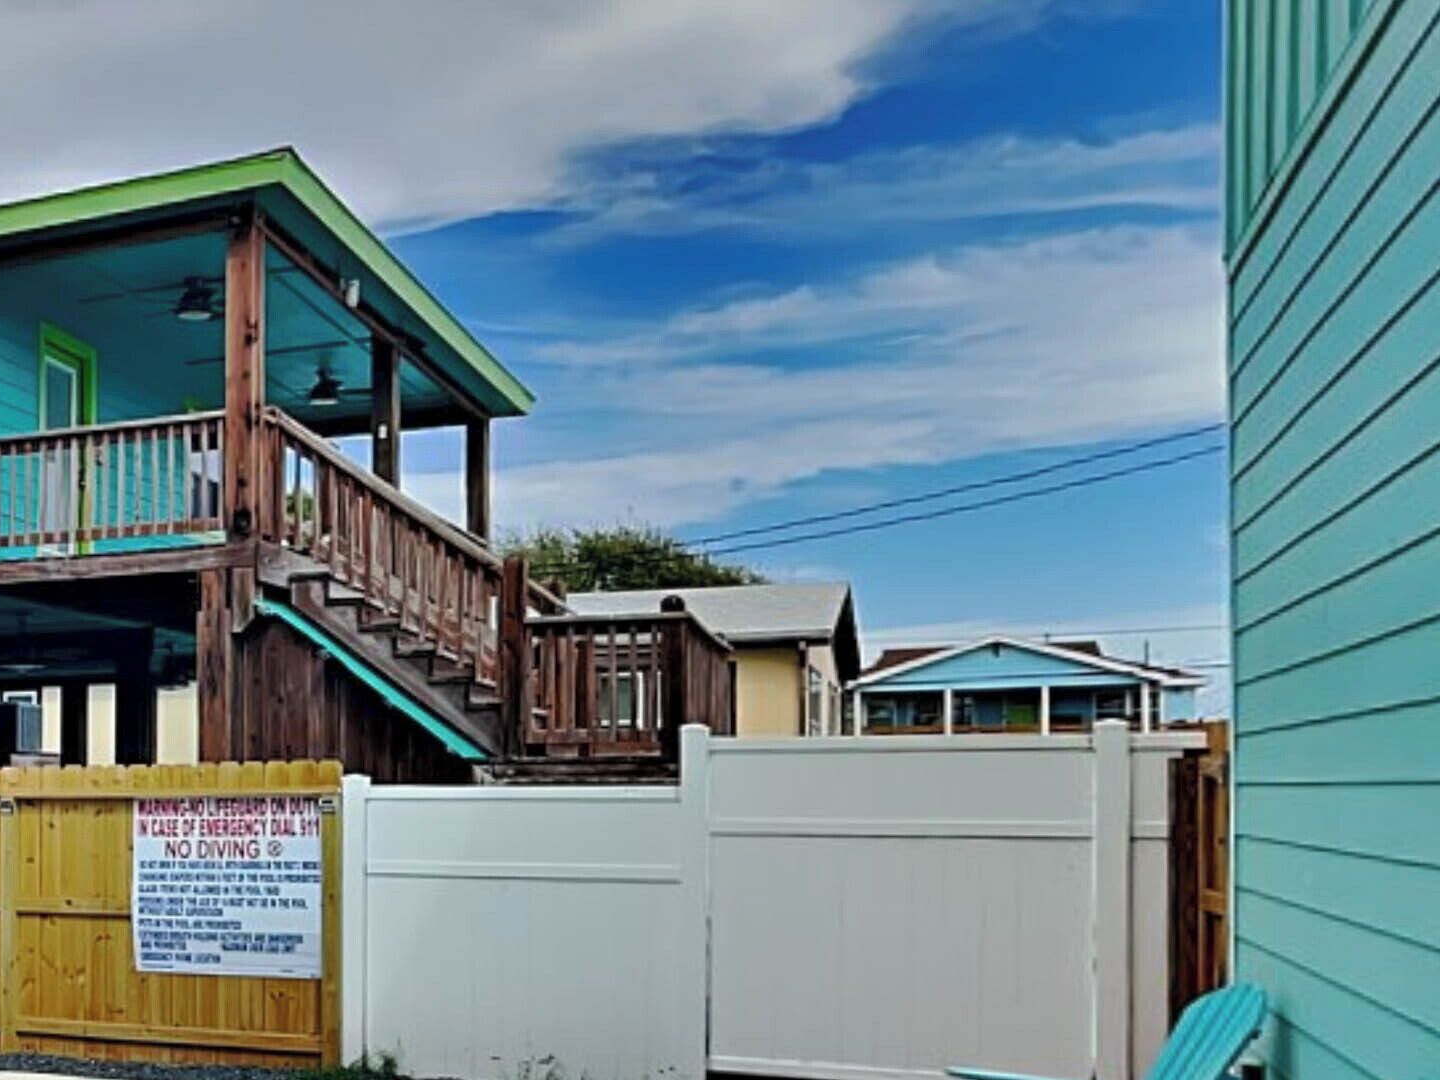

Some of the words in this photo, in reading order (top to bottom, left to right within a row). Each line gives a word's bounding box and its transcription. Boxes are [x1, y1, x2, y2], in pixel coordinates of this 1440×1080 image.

[207, 797, 268, 817] LIFEGUARD
[270, 797, 287, 816] ON
[151, 819, 178, 838] CASE
[180, 819, 195, 838] OF
[199, 819, 268, 838] EMERGENCY
[270, 819, 297, 838] DIAL
[299, 819, 320, 838] 911
[164, 839, 191, 859] NO
[198, 839, 260, 859] DIVING
